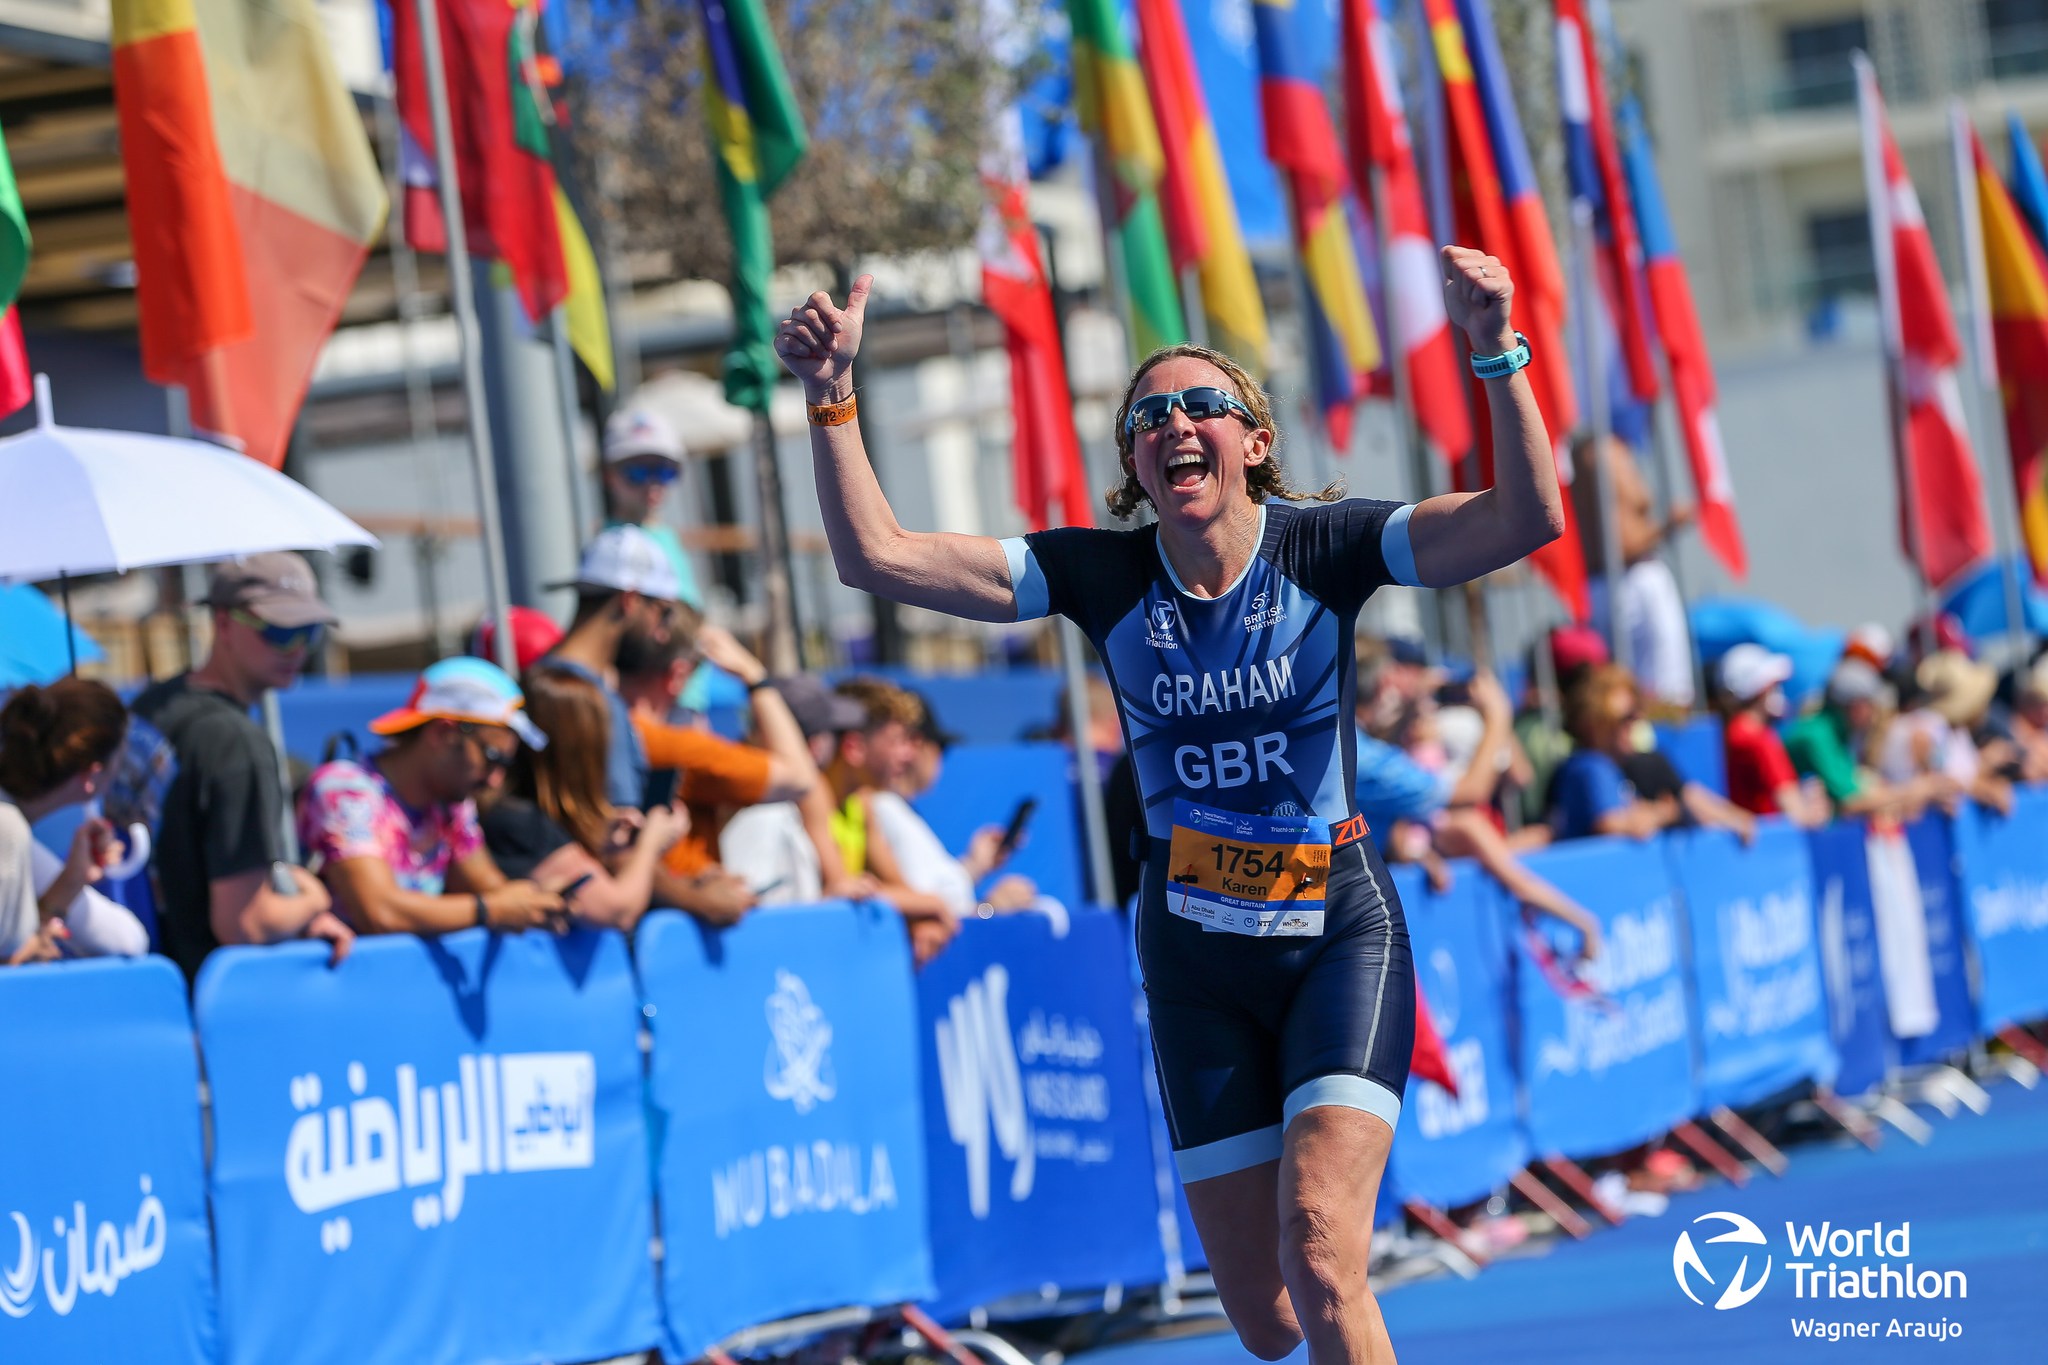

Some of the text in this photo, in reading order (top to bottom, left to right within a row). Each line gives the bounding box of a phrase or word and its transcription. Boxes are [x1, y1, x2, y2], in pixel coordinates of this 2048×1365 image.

[812, 411, 837, 423] W12
[1243, 603, 1285, 626] BRITISH
[1245, 613, 1287, 633] TRIATHLON
[1145, 637, 1178, 649] Triathlon
[1151, 631, 1173, 641] World
[1152, 655, 1296, 716] GRAHAM
[1174, 731, 1295, 789] GBR
[1211, 843, 1285, 879] 1754
[1221, 876, 1267, 896] Karen
[1220, 896, 1266, 909] GREAT BRITAIN
[42, 1173, 167, 1316] ضمان
